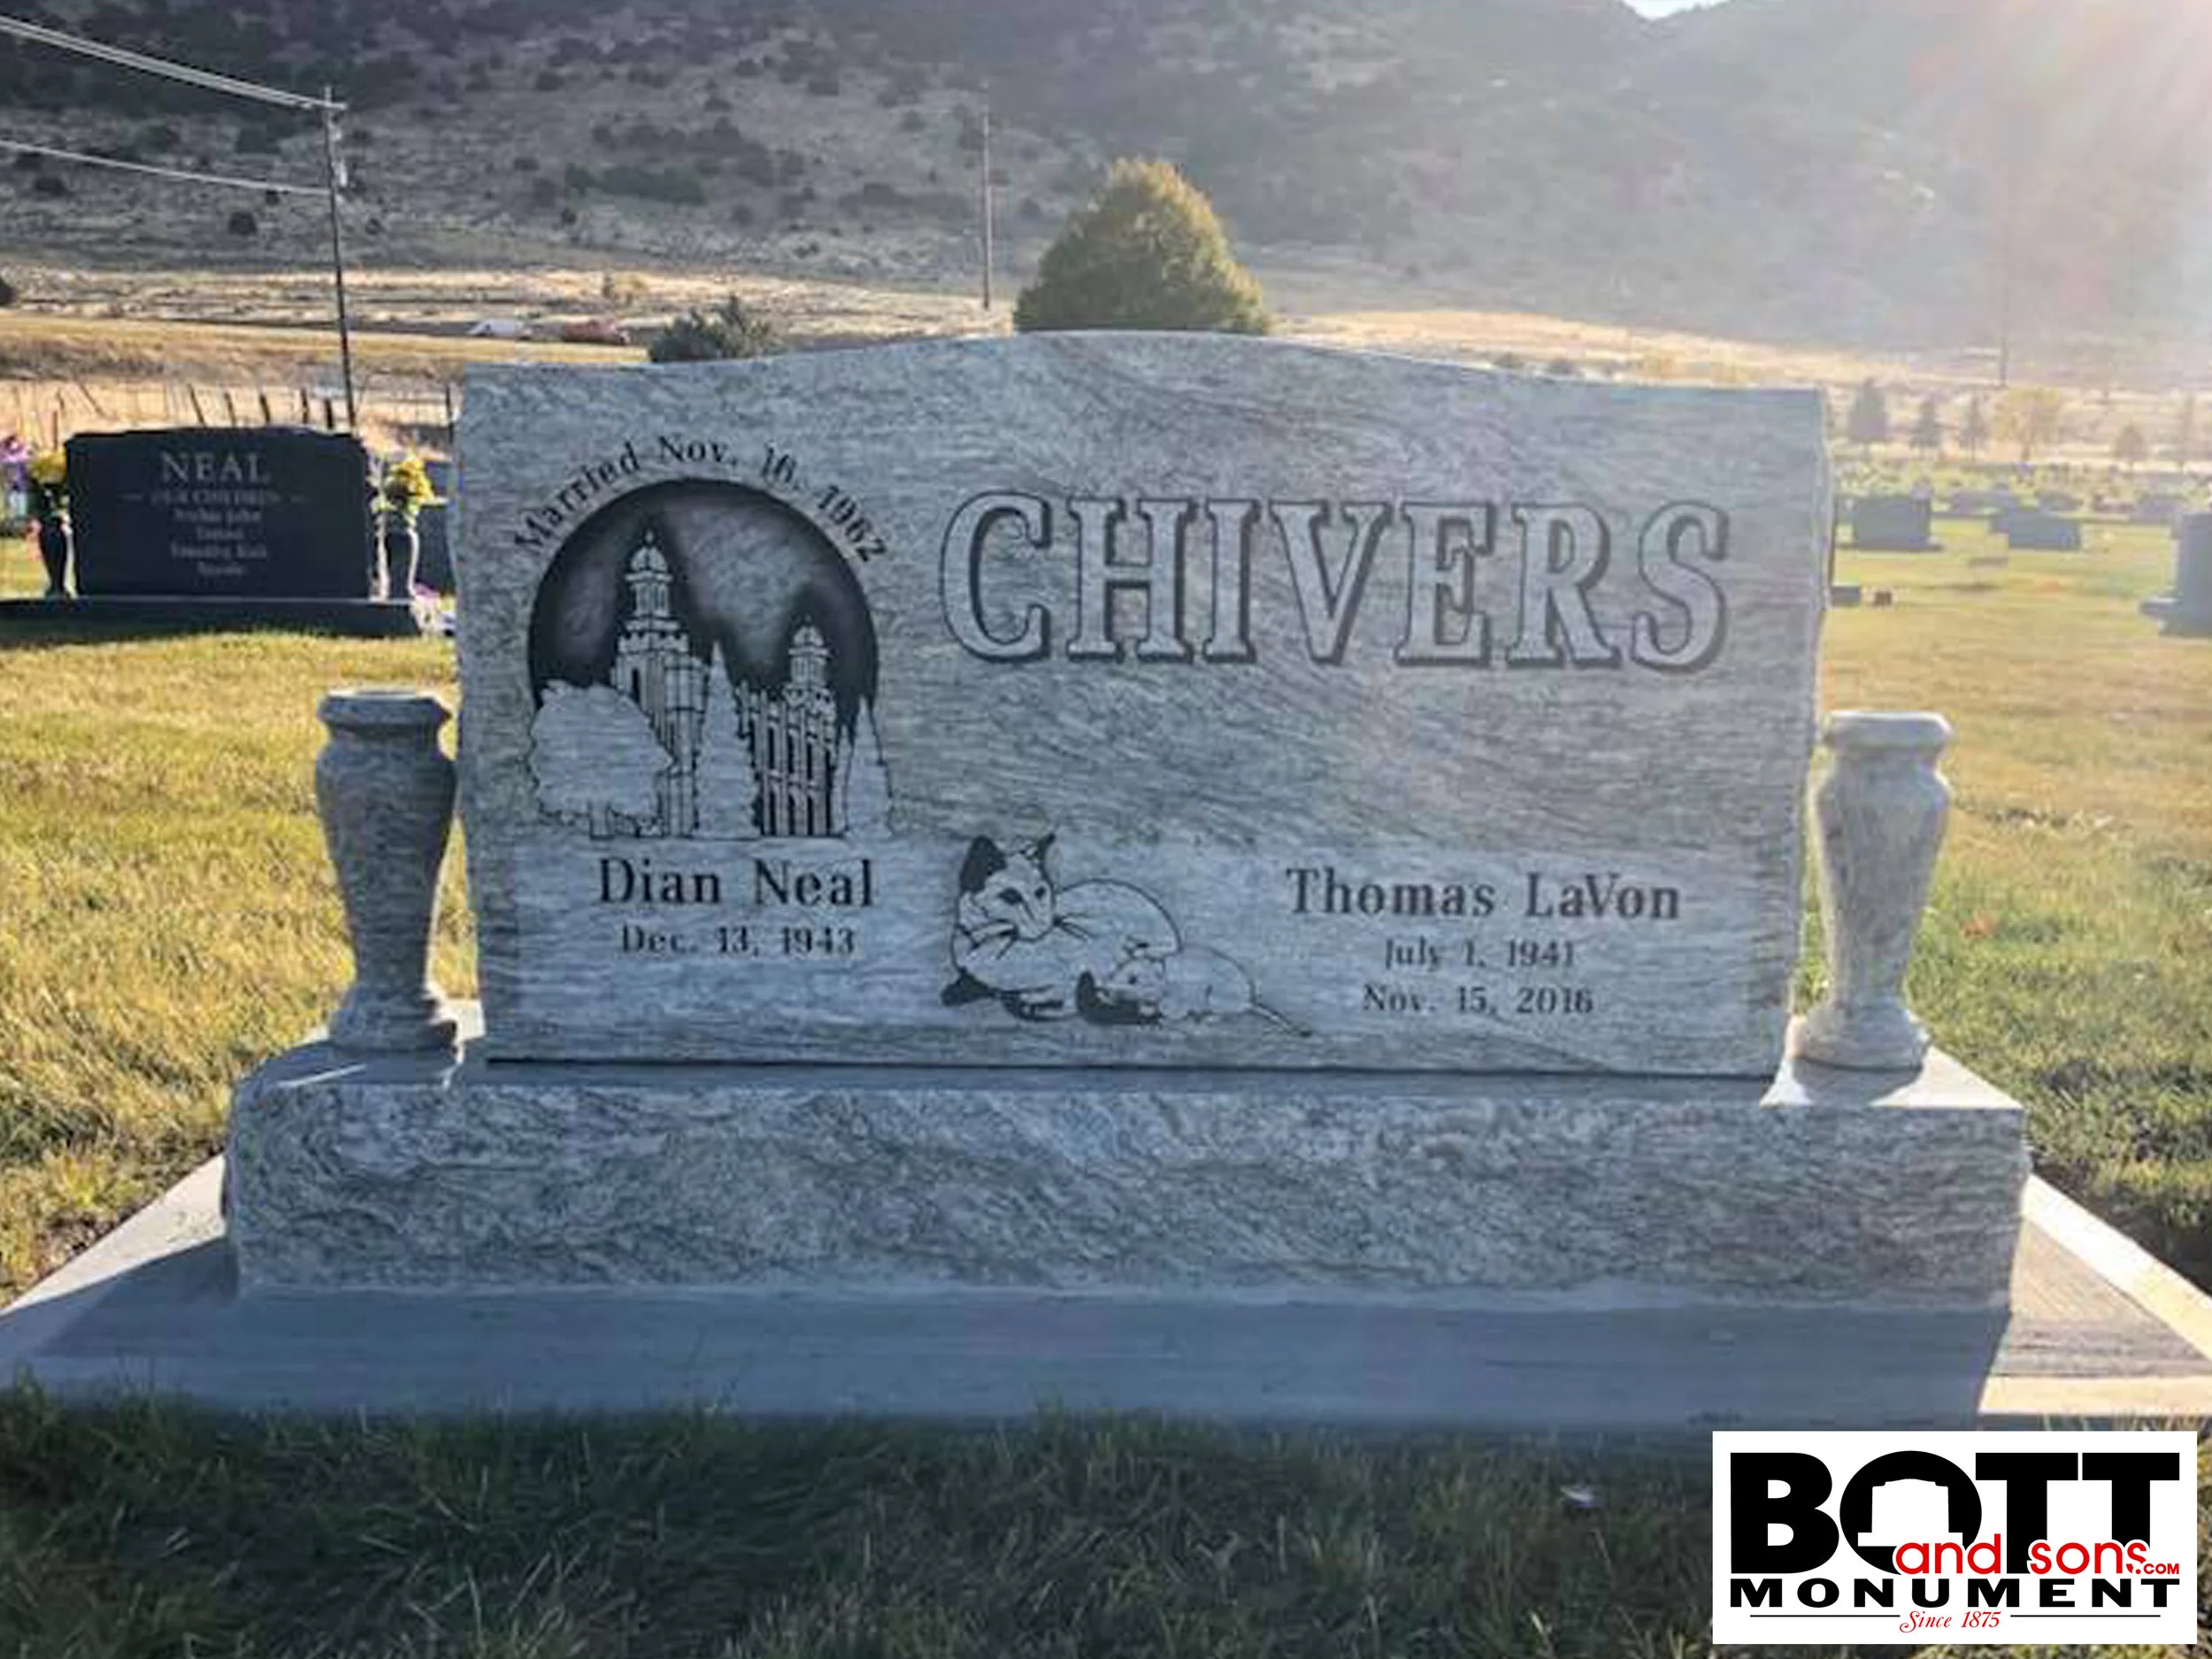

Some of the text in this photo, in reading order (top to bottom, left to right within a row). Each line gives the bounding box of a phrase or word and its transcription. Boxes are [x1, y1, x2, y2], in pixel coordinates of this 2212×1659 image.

[160, 450, 273, 484] NEAL
[514, 441, 641, 549] Married
[659, 435, 738, 467] Nov.
[817, 485, 888, 563] 1962
[940, 490, 1730, 674] CHIVERS
[600, 857, 874, 908] Dian Neal
[1286, 866, 1681, 921] Thomas LaVon
[621, 925, 856, 957] Dec. 13, 1943
[1385, 936, 1440, 972] July
[1506, 939, 1576, 969] 1941
[1363, 984, 1594, 1017] Nov. 15, 2016
